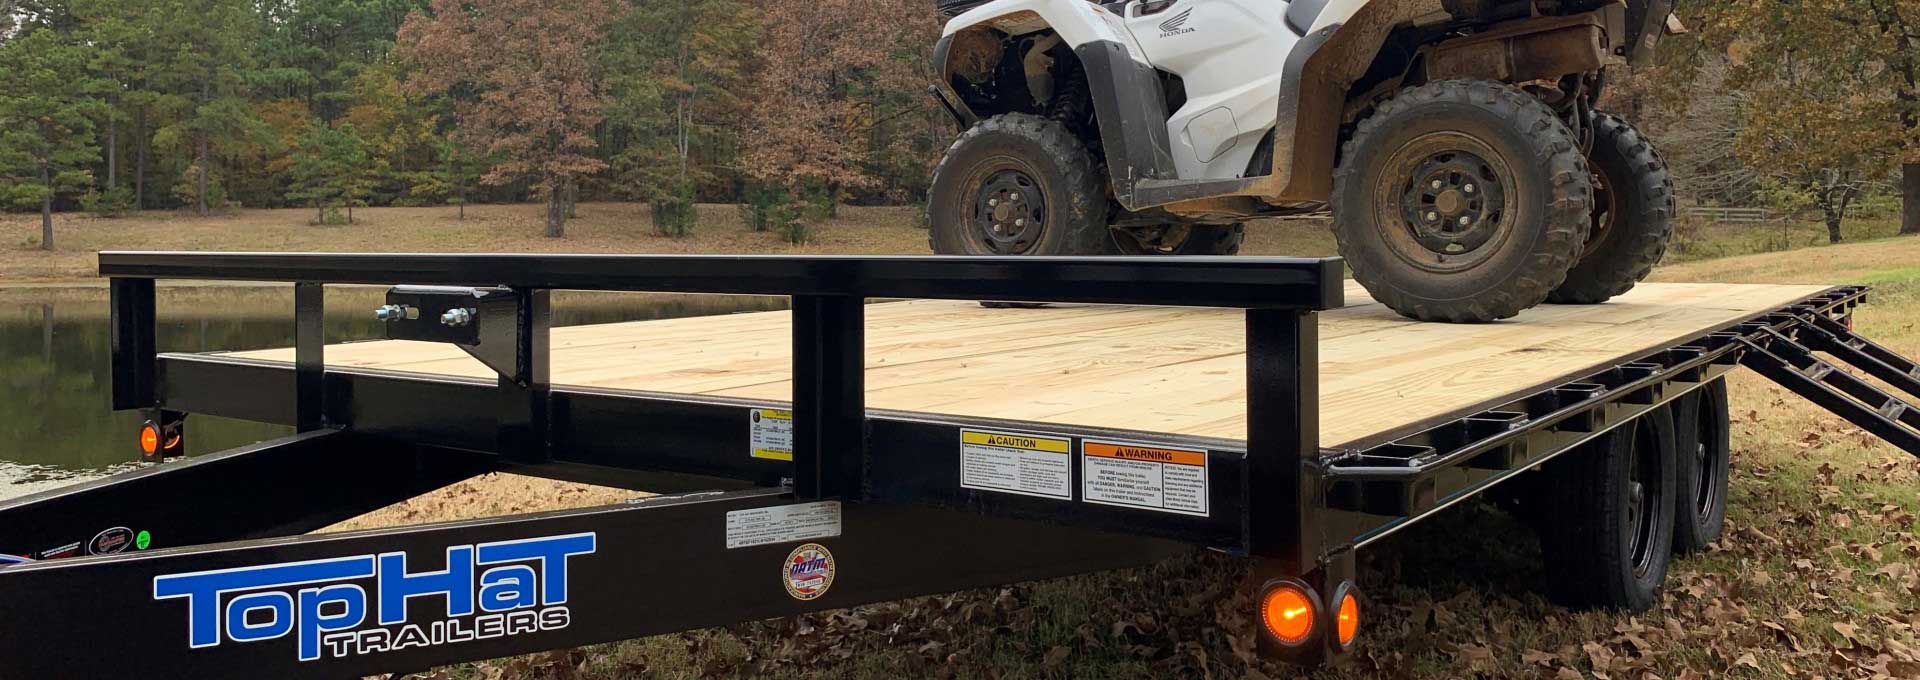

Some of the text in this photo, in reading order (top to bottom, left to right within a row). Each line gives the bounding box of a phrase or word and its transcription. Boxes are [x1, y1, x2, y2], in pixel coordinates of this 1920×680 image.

[1159, 27, 1195, 38] HONDA
[996, 436, 1036, 448] CAUTION
[1124, 447, 1172, 461] WARNING
[324, 605, 570, 658] TRAILERS
